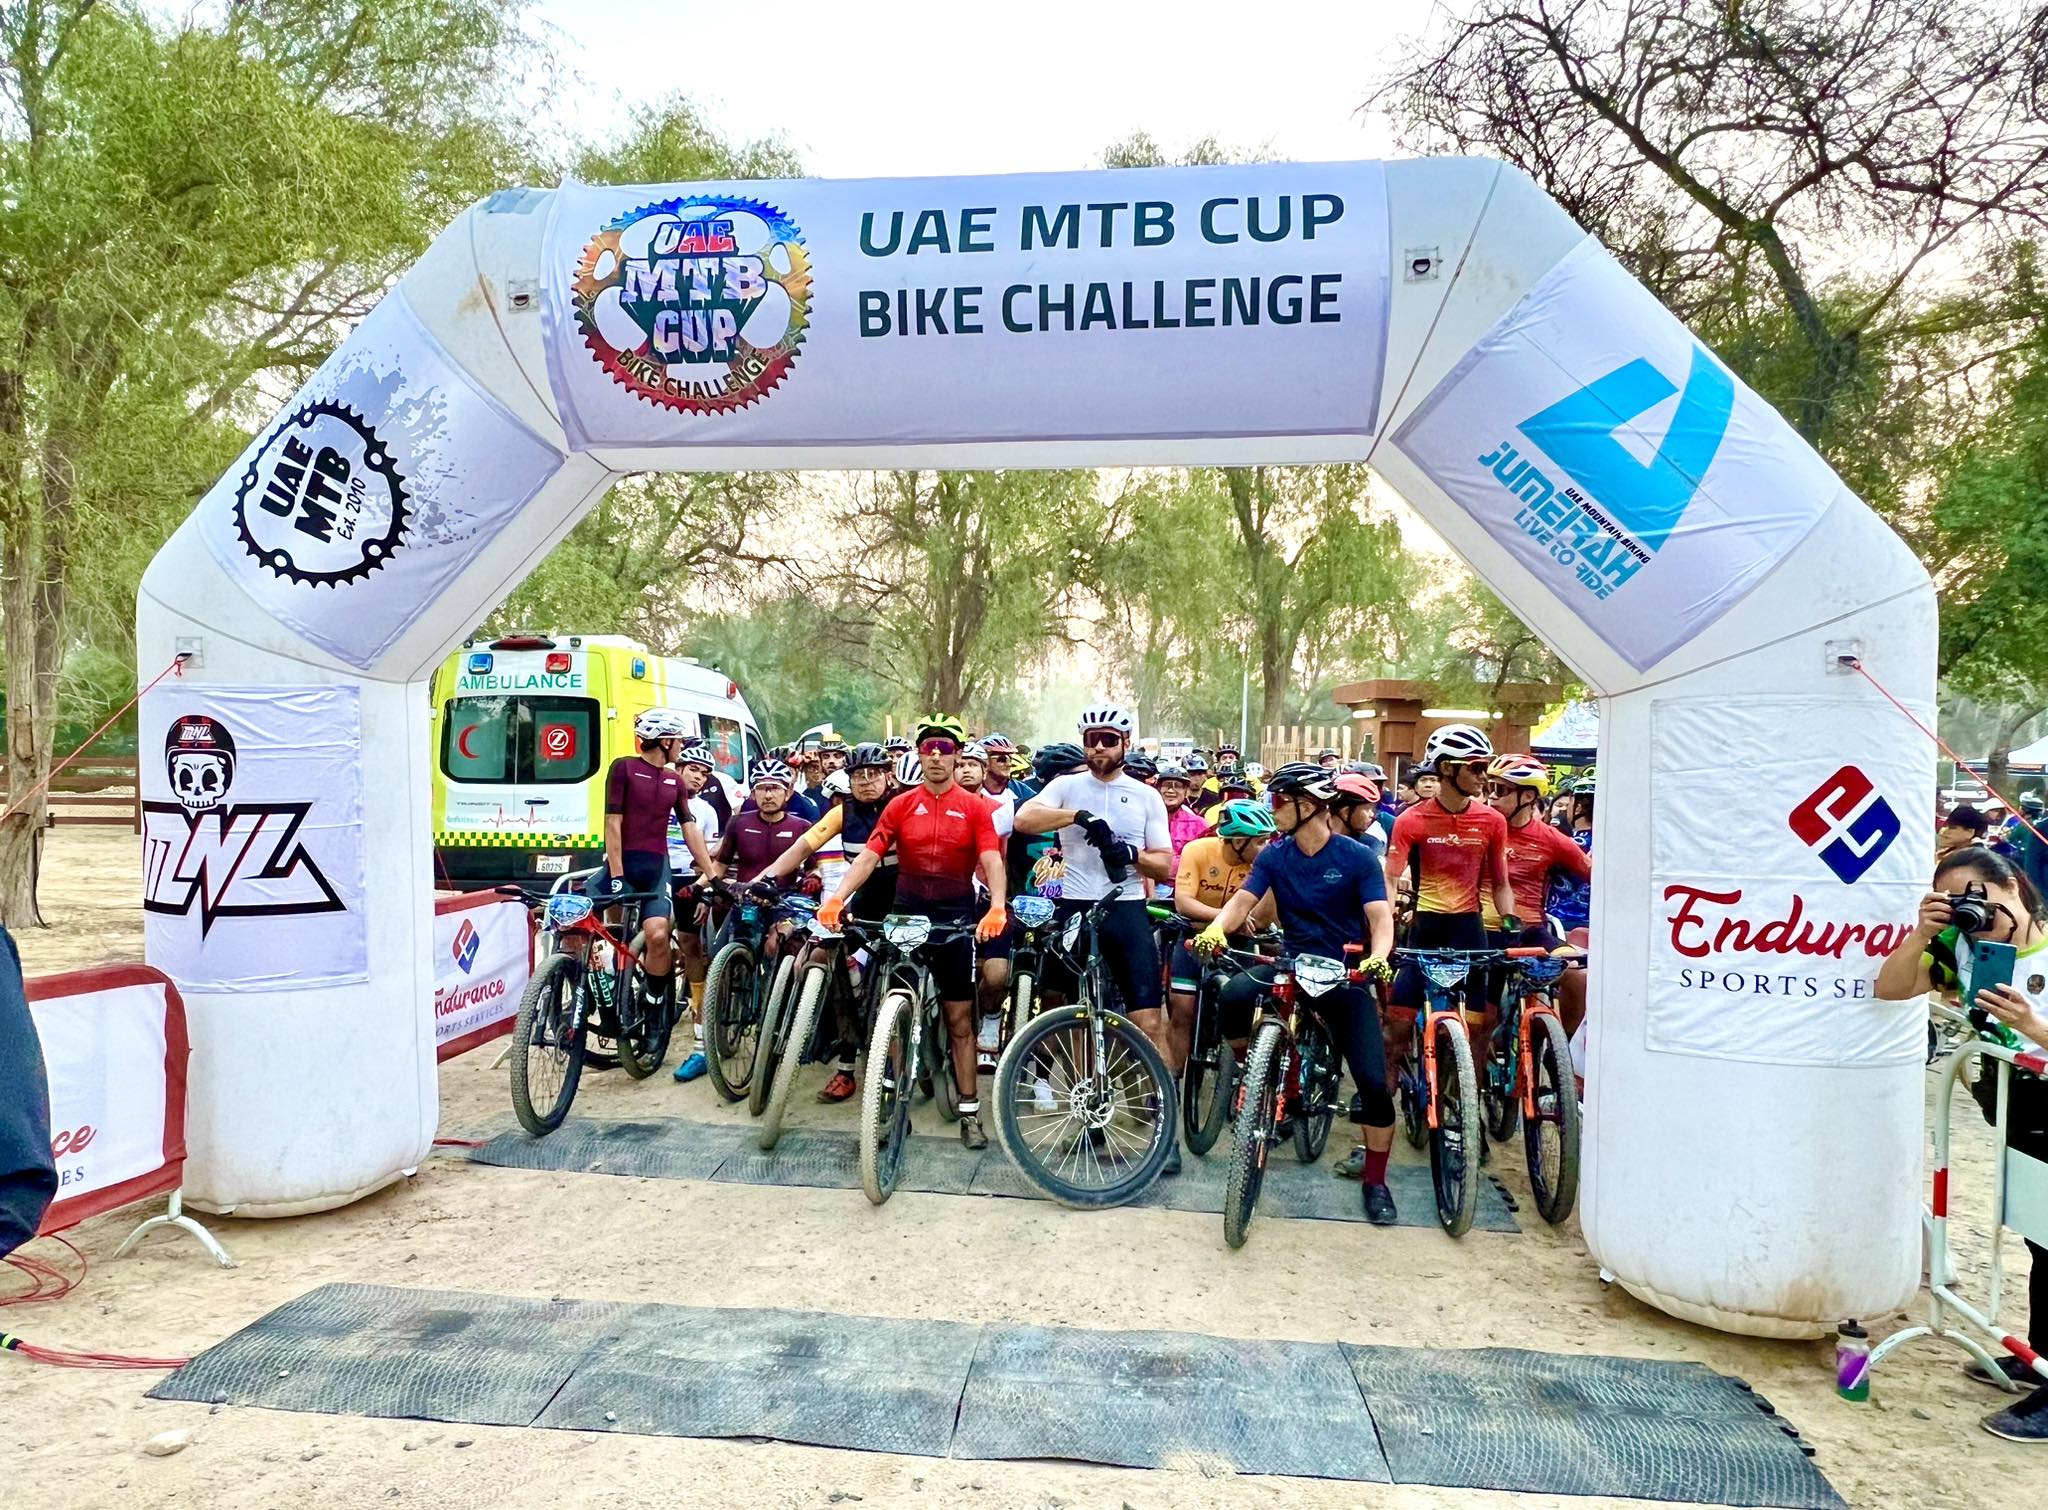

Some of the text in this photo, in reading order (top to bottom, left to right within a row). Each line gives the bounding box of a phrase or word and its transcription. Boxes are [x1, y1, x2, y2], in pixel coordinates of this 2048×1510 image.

[653, 220, 734, 255] UAE
[859, 193, 1345, 257] UAE MTB CUP
[620, 256, 767, 303] MTB
[858, 273, 1343, 337] BIKE CHALLENGE
[653, 308, 737, 353] CUP
[616, 347, 770, 400] BIKE CHALLENGE
[259, 435, 313, 517] UAE
[294, 446, 351, 544] MTB
[346, 477, 367, 514] 2010
[1565, 487, 1651, 564] UAE MOUNTAIN BIKING
[457, 673, 582, 690] AMBULANCE
[1679, 968, 1819, 998] SPORTS
